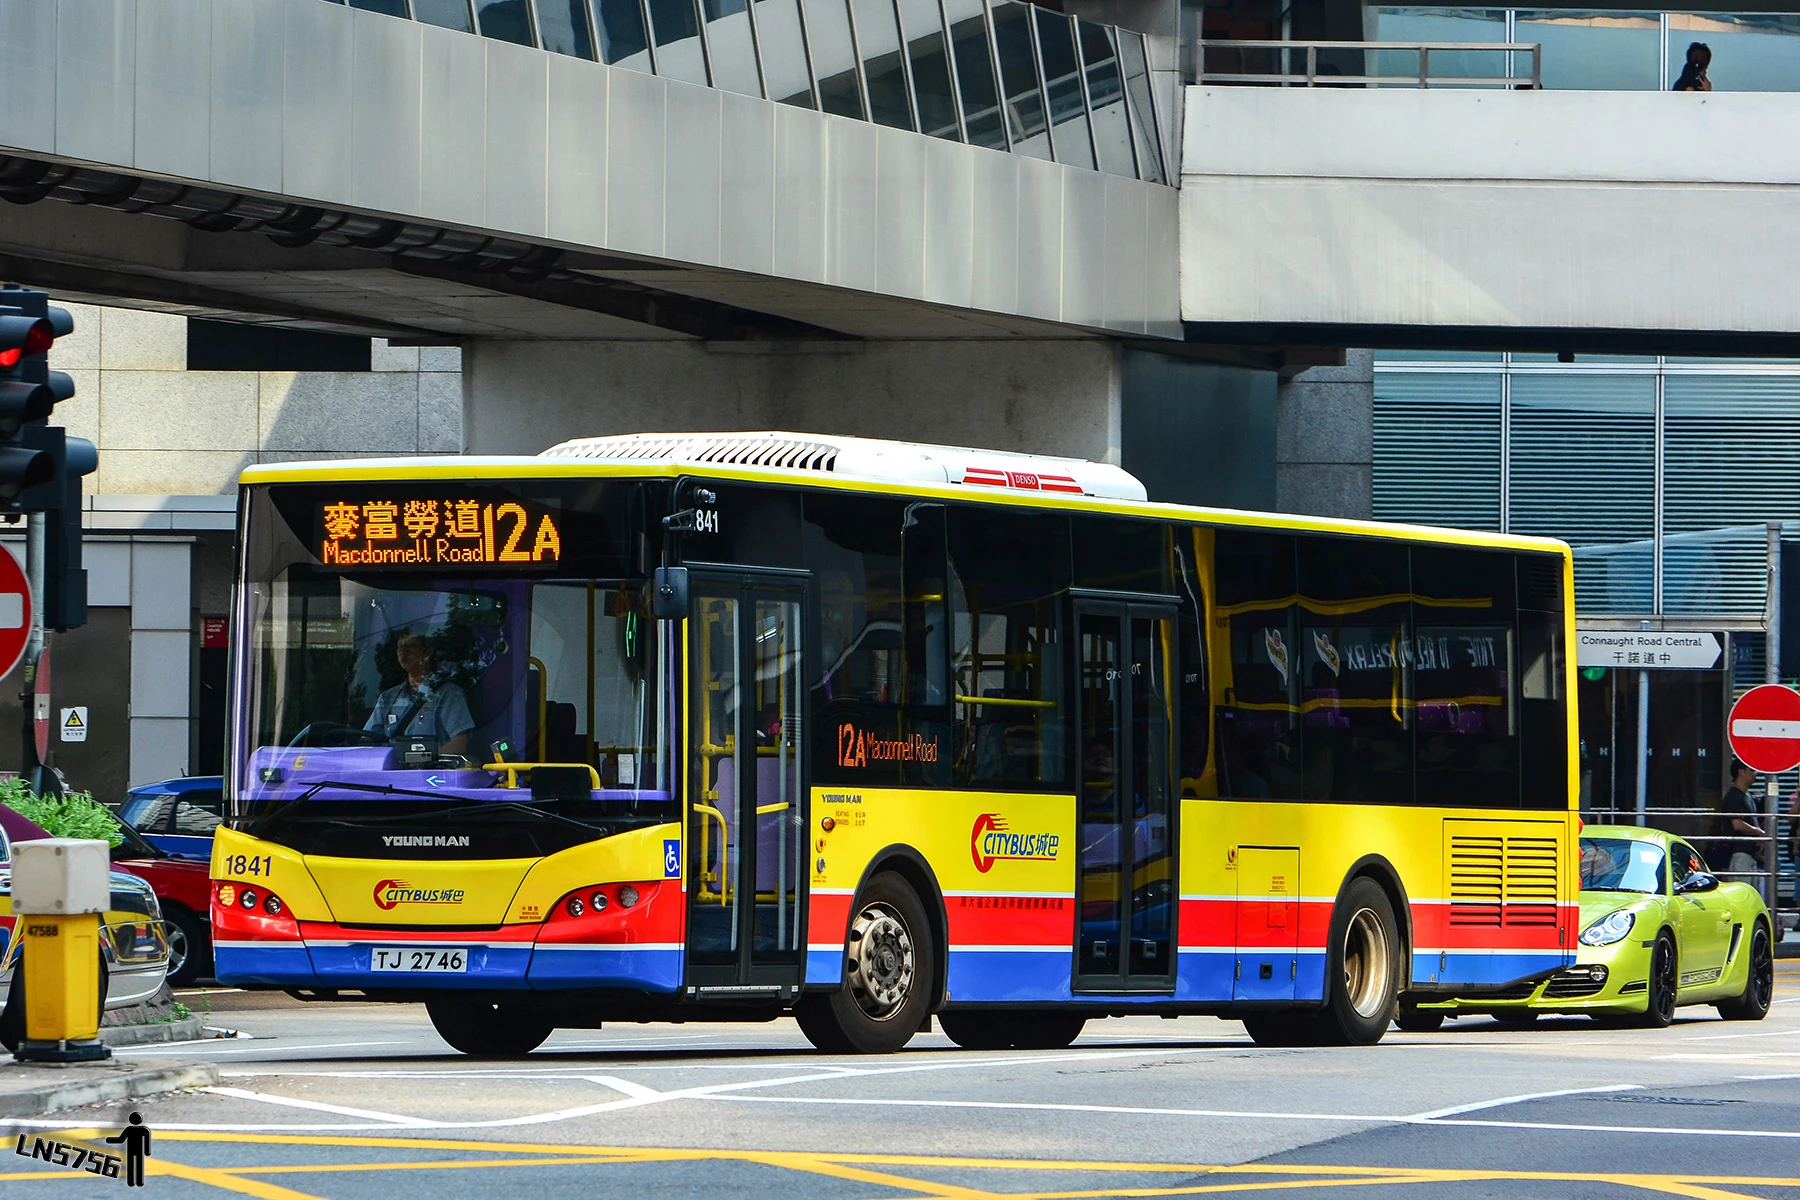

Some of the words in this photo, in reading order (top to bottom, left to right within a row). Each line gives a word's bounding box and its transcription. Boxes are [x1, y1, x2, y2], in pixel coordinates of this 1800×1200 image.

[1016, 475, 1036, 485] DENSO
[324, 500, 482, 539] 麥當勞道
[693, 509, 718, 533] 841
[483, 502, 561, 562] 12A
[323, 540, 431, 563] Macdonnell
[436, 539, 483, 562] Road
[1581, 636, 1634, 647] Connaught
[1637, 637, 1662, 646] Road
[1665, 638, 1702, 646] Central
[838, 723, 866, 767] 12A
[984, 833, 1036, 856] CITYBUS
[1036, 833, 1060, 857] 城巴
[226, 855, 272, 877] 1841
[386, 889, 440, 901] CITYBUS
[440, 888, 465, 902] 城巴
[377, 951, 402, 969] TJ
[410, 951, 462, 970] 2746
